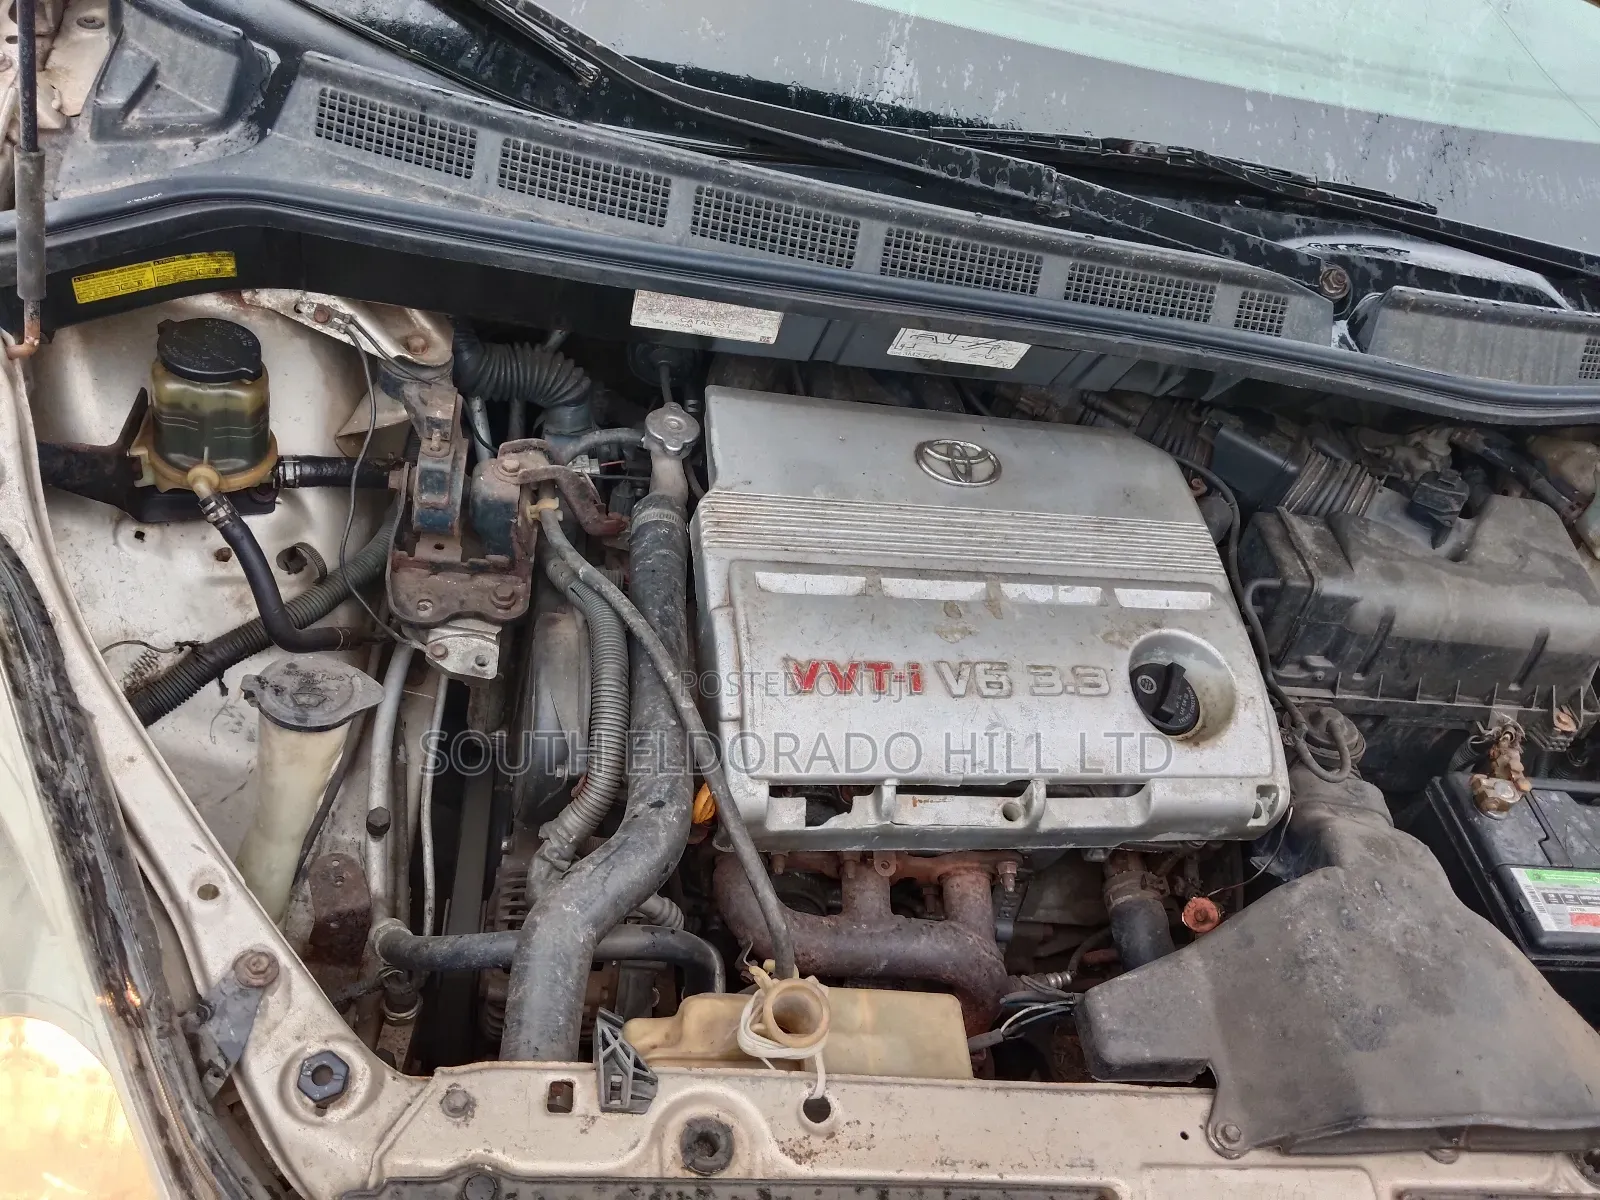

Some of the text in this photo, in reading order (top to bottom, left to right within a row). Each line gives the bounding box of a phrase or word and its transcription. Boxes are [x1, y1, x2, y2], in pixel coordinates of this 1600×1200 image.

[680, 316, 731, 329] CATALYST
[782, 657, 1112, 699] VVT-i V6 3.3
